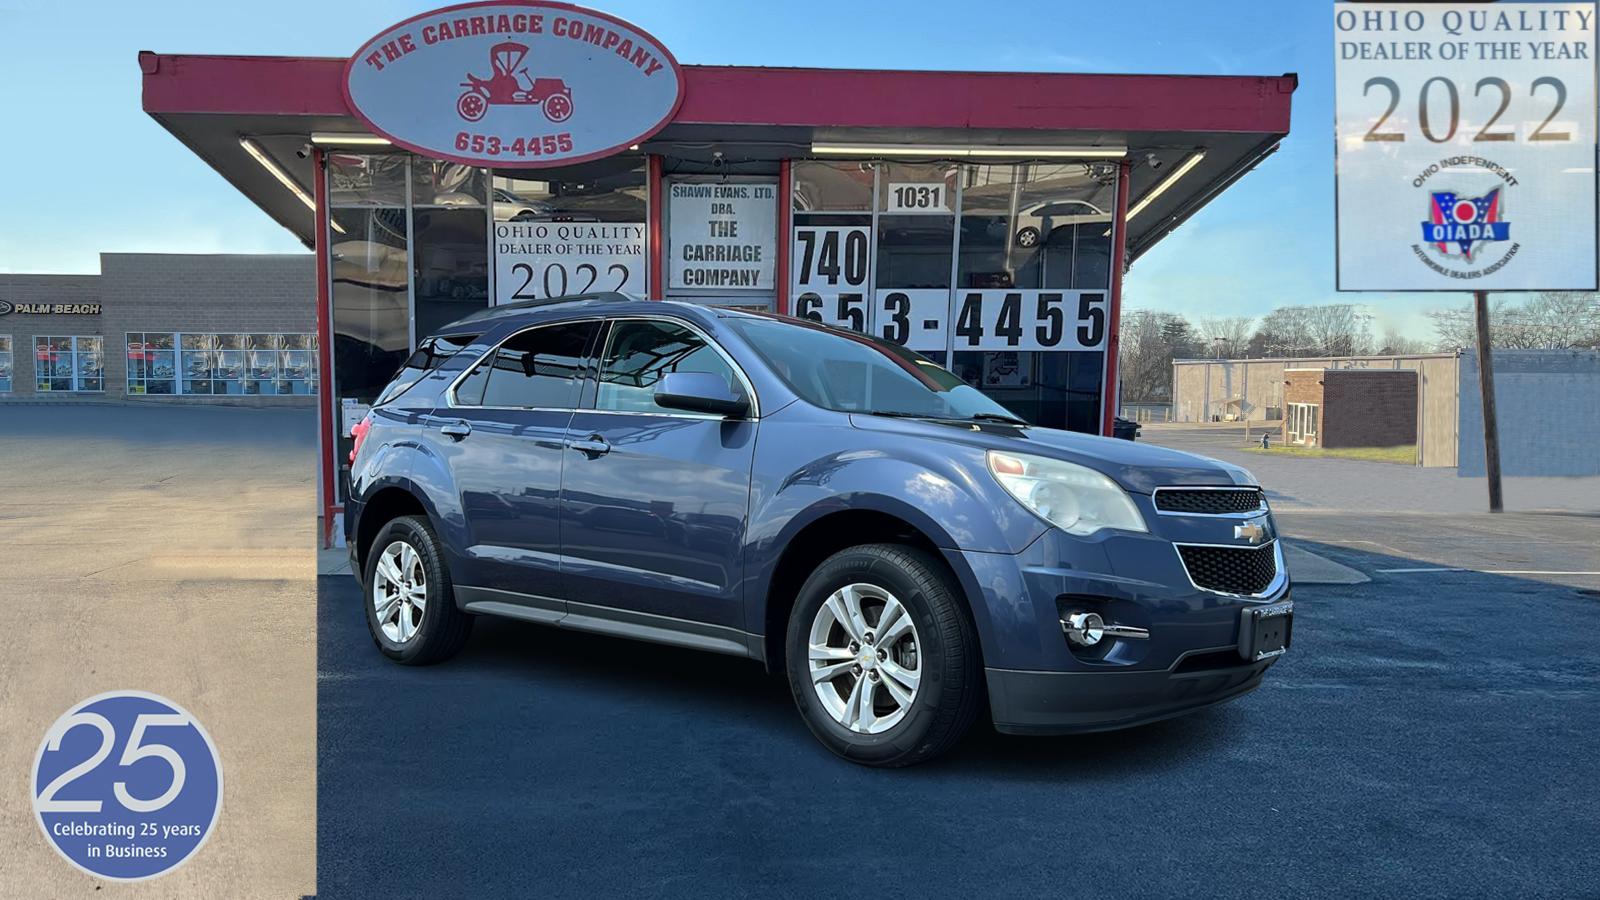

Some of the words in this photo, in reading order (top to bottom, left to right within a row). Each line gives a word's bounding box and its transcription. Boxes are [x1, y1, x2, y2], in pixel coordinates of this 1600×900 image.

[1336, 10, 1425, 31] OHIO
[1442, 10, 1592, 36] QUALITY
[366, 33, 416, 72] THE
[422, 14, 543, 45] CARRIAGE
[553, 17, 664, 77] COMPANY
[1340, 42, 1433, 60] DEALER
[1439, 42, 1469, 60] OF
[1475, 42, 1521, 60] THE
[1528, 42, 1589, 60] YEAR
[1362, 76, 1571, 143] 2022
[455, 132, 573, 157] 653-4455
[1412, 164, 1439, 188] OHIO
[1440, 155, 1519, 187] INDEPENDENT
[672, 186, 711, 198] SHAWN
[754, 187, 774, 199] LTD.
[894, 186, 941, 208] 1031
[711, 203, 736, 215] DBA.
[497, 226, 548, 239] OHIO
[558, 225, 645, 241] QUALITY
[708, 220, 738, 237] THE
[1432, 224, 1495, 241] OIADA
[499, 243, 551, 255] DEALER
[555, 243, 573, 255] OF
[576, 243, 602, 255] THE
[606, 243, 641, 255] YEAR
[683, 244, 762, 262] CARRIAGE
[797, 230, 868, 286] 740
[1411, 244, 1449, 276] AUTOMOBILE
[1450, 270, 1482, 279] DEALERS
[511, 262, 630, 300] 2022
[683, 268, 760, 286] COMPANY
[15, 304, 50, 314] PALM
[54, 304, 100, 314] BEACH
